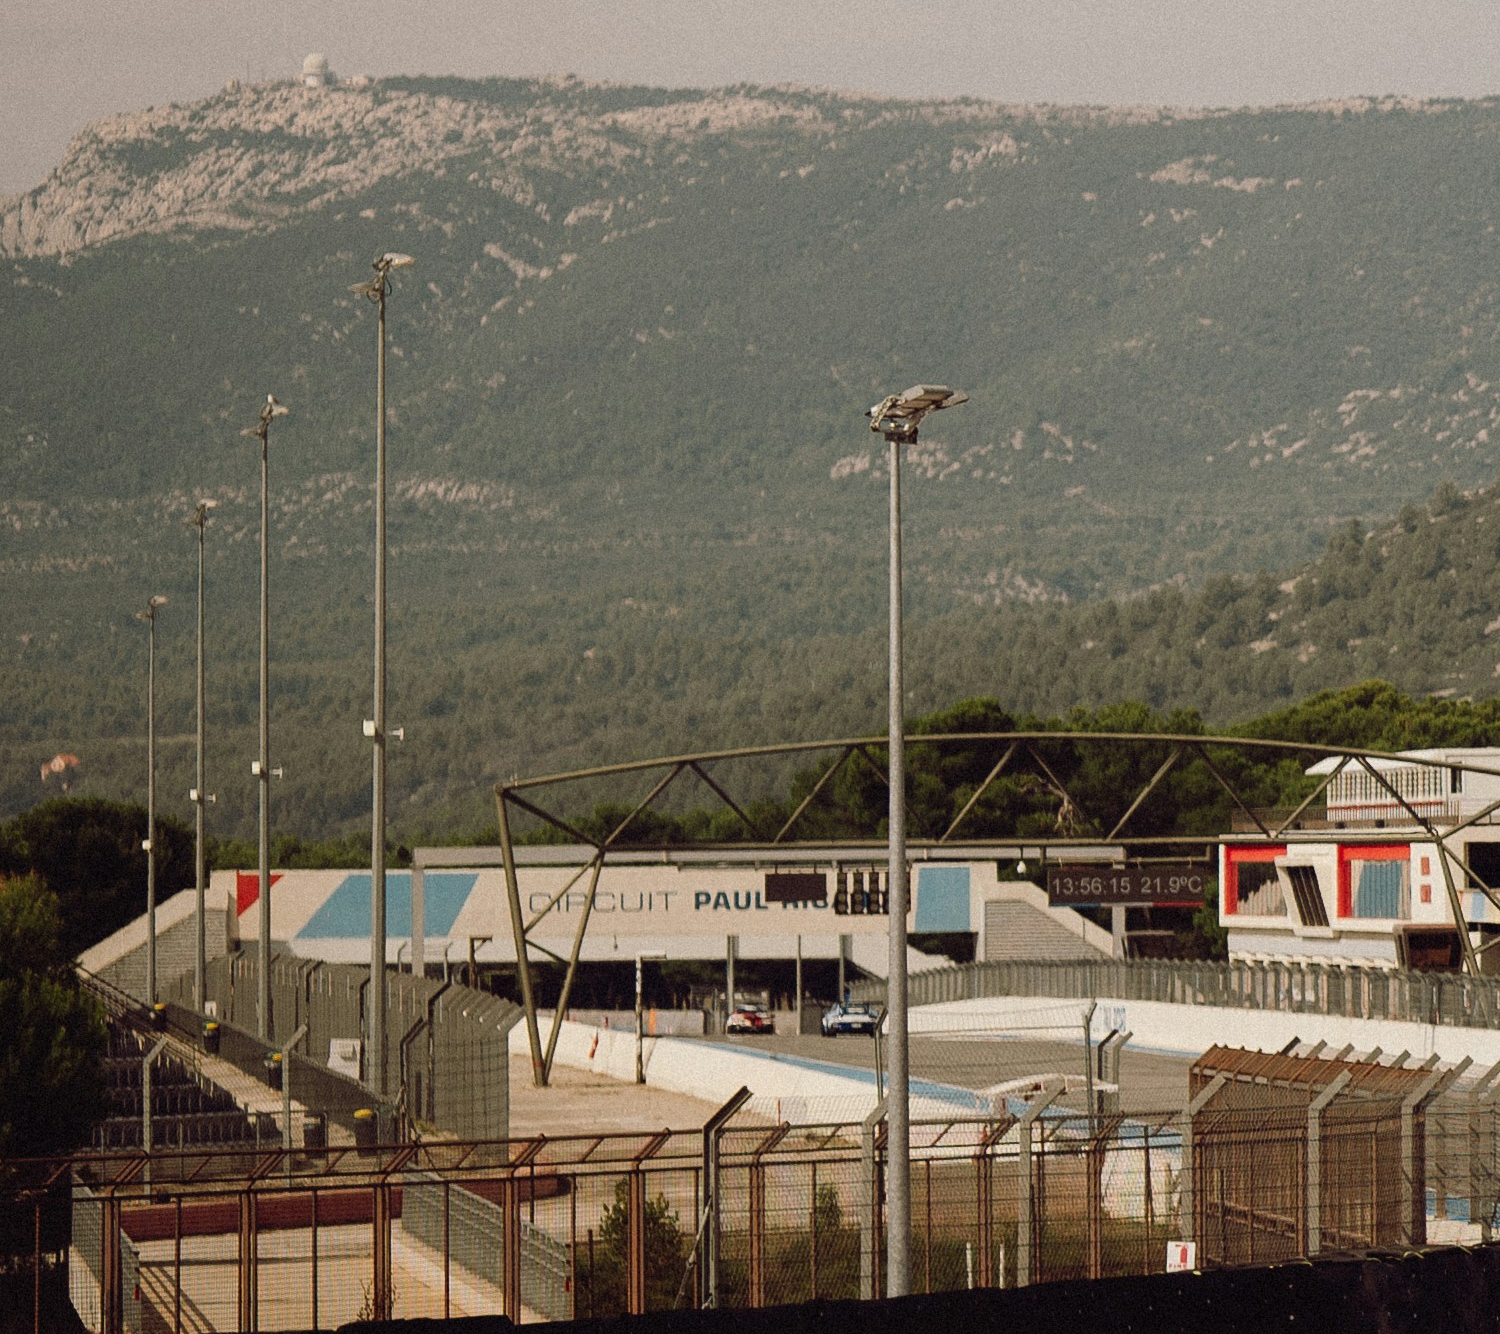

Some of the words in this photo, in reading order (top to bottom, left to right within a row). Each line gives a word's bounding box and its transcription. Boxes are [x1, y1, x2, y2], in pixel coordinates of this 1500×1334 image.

[1053, 876, 1131, 896] 13:56:15
[528, 891, 678, 914] CIRCUIT
[694, 890, 769, 911] PAUL
